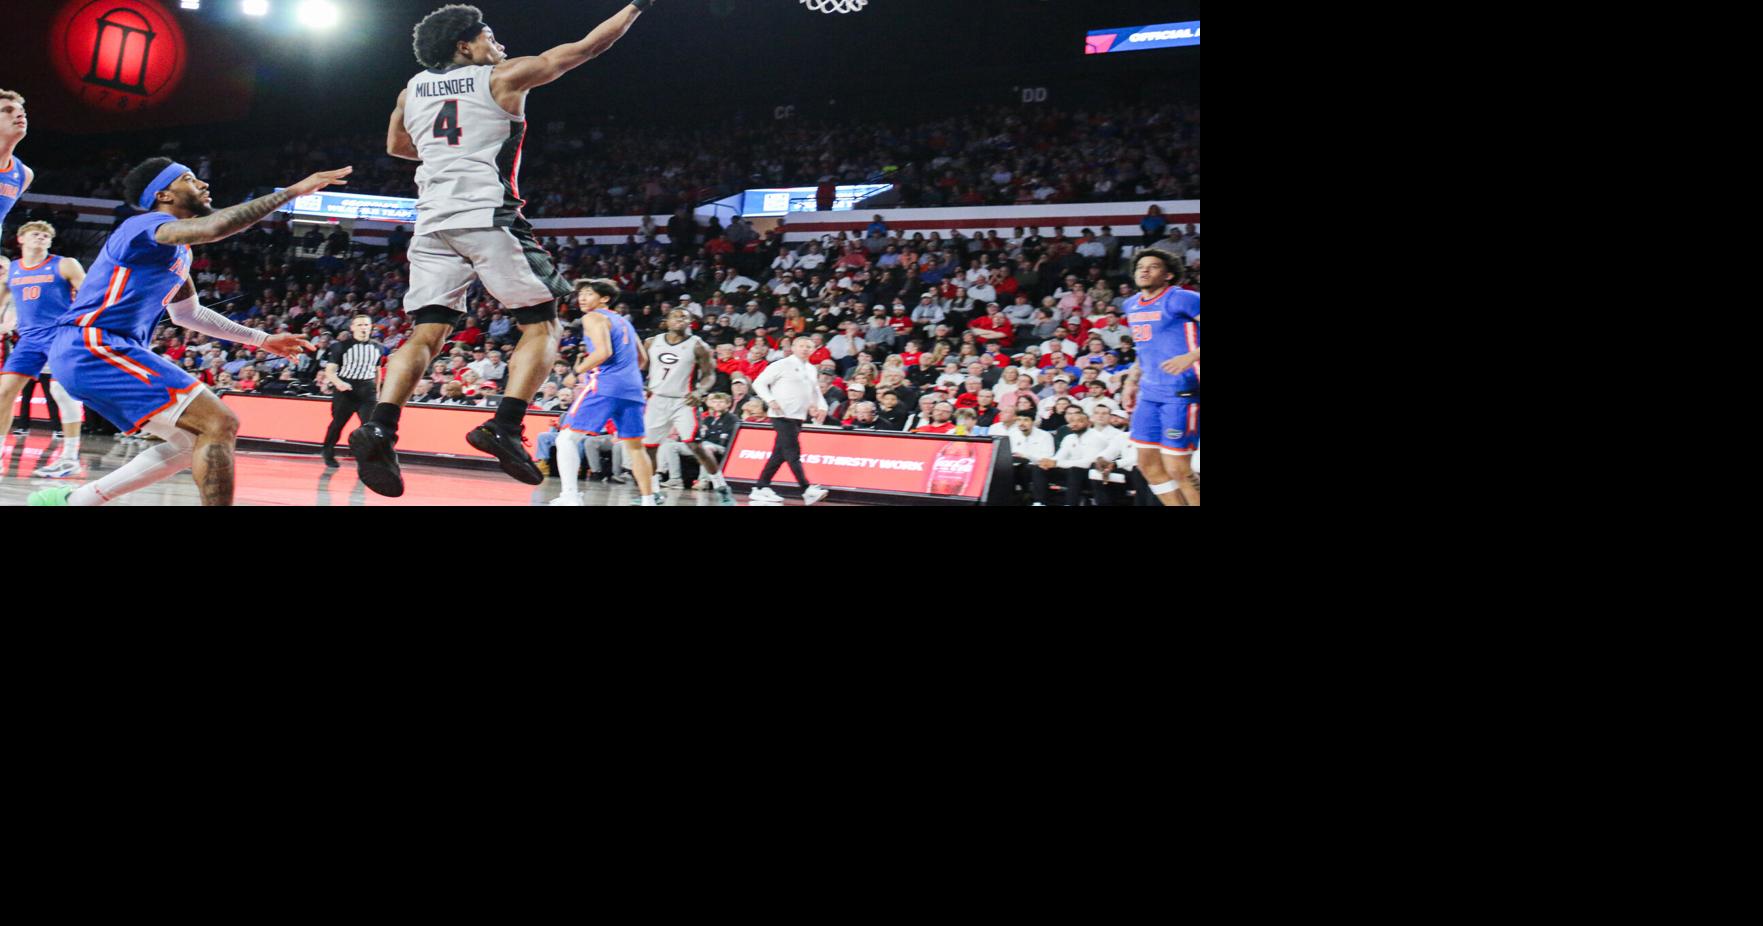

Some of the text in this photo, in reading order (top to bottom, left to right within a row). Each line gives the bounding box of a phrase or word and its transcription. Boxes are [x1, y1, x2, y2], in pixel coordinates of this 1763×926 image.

[415, 77, 475, 97] MILLENDER
[1022, 87, 1047, 102] DD
[432, 98, 463, 147] 4
[23, 286, 41, 302] 10
[658, 352, 681, 365] G
[822, 455, 880, 468] THIRSTY
[880, 459, 925, 471] WORK
